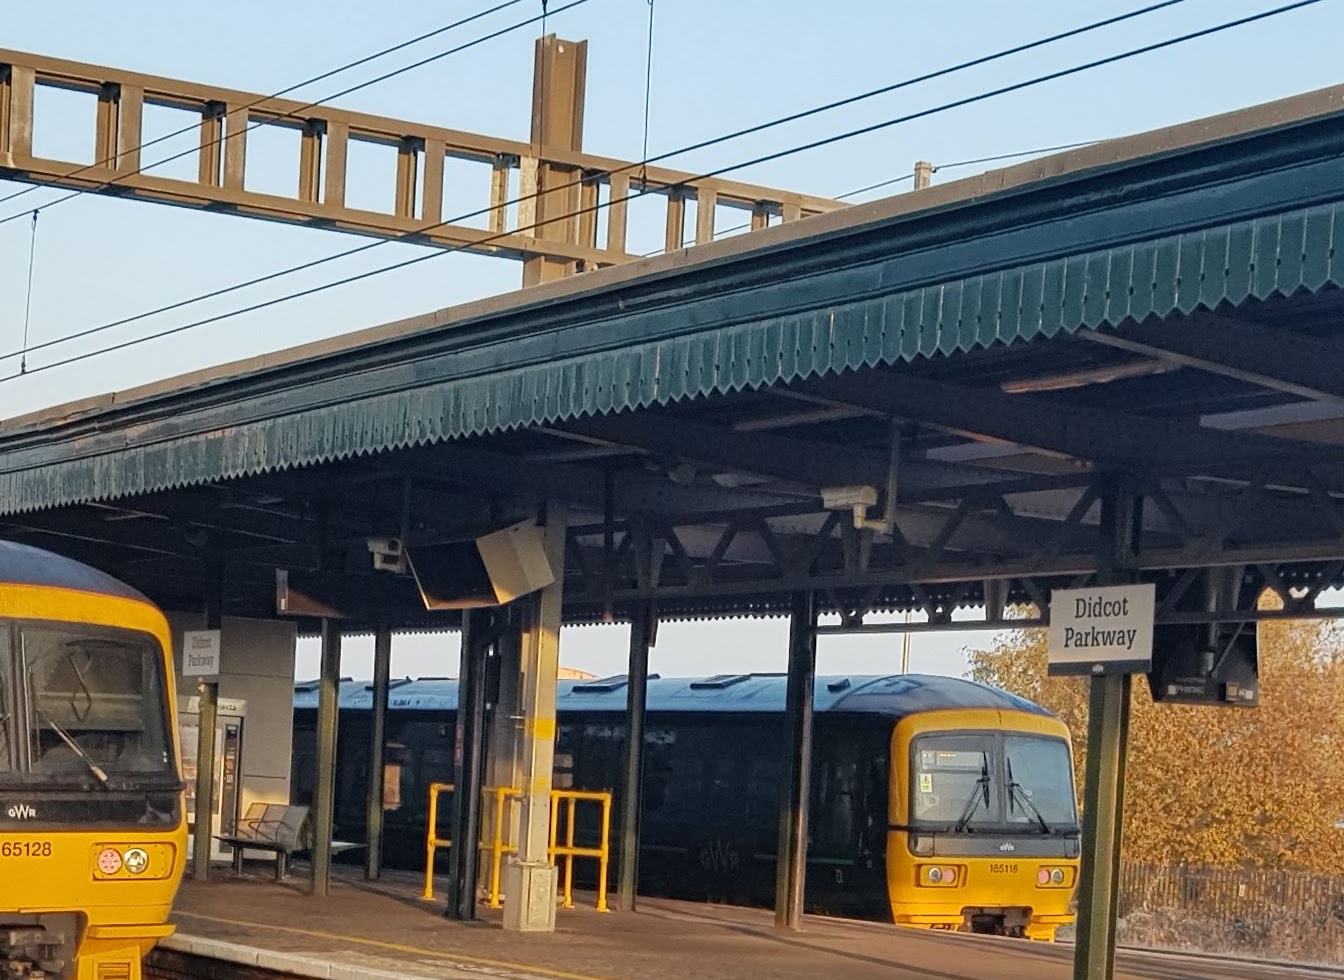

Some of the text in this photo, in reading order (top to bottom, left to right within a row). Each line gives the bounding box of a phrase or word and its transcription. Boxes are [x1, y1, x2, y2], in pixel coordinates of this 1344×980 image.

[1074, 596, 1129, 619] Didcot
[1063, 626, 1137, 650] Parkway
[8, 803, 37, 819] GWR
